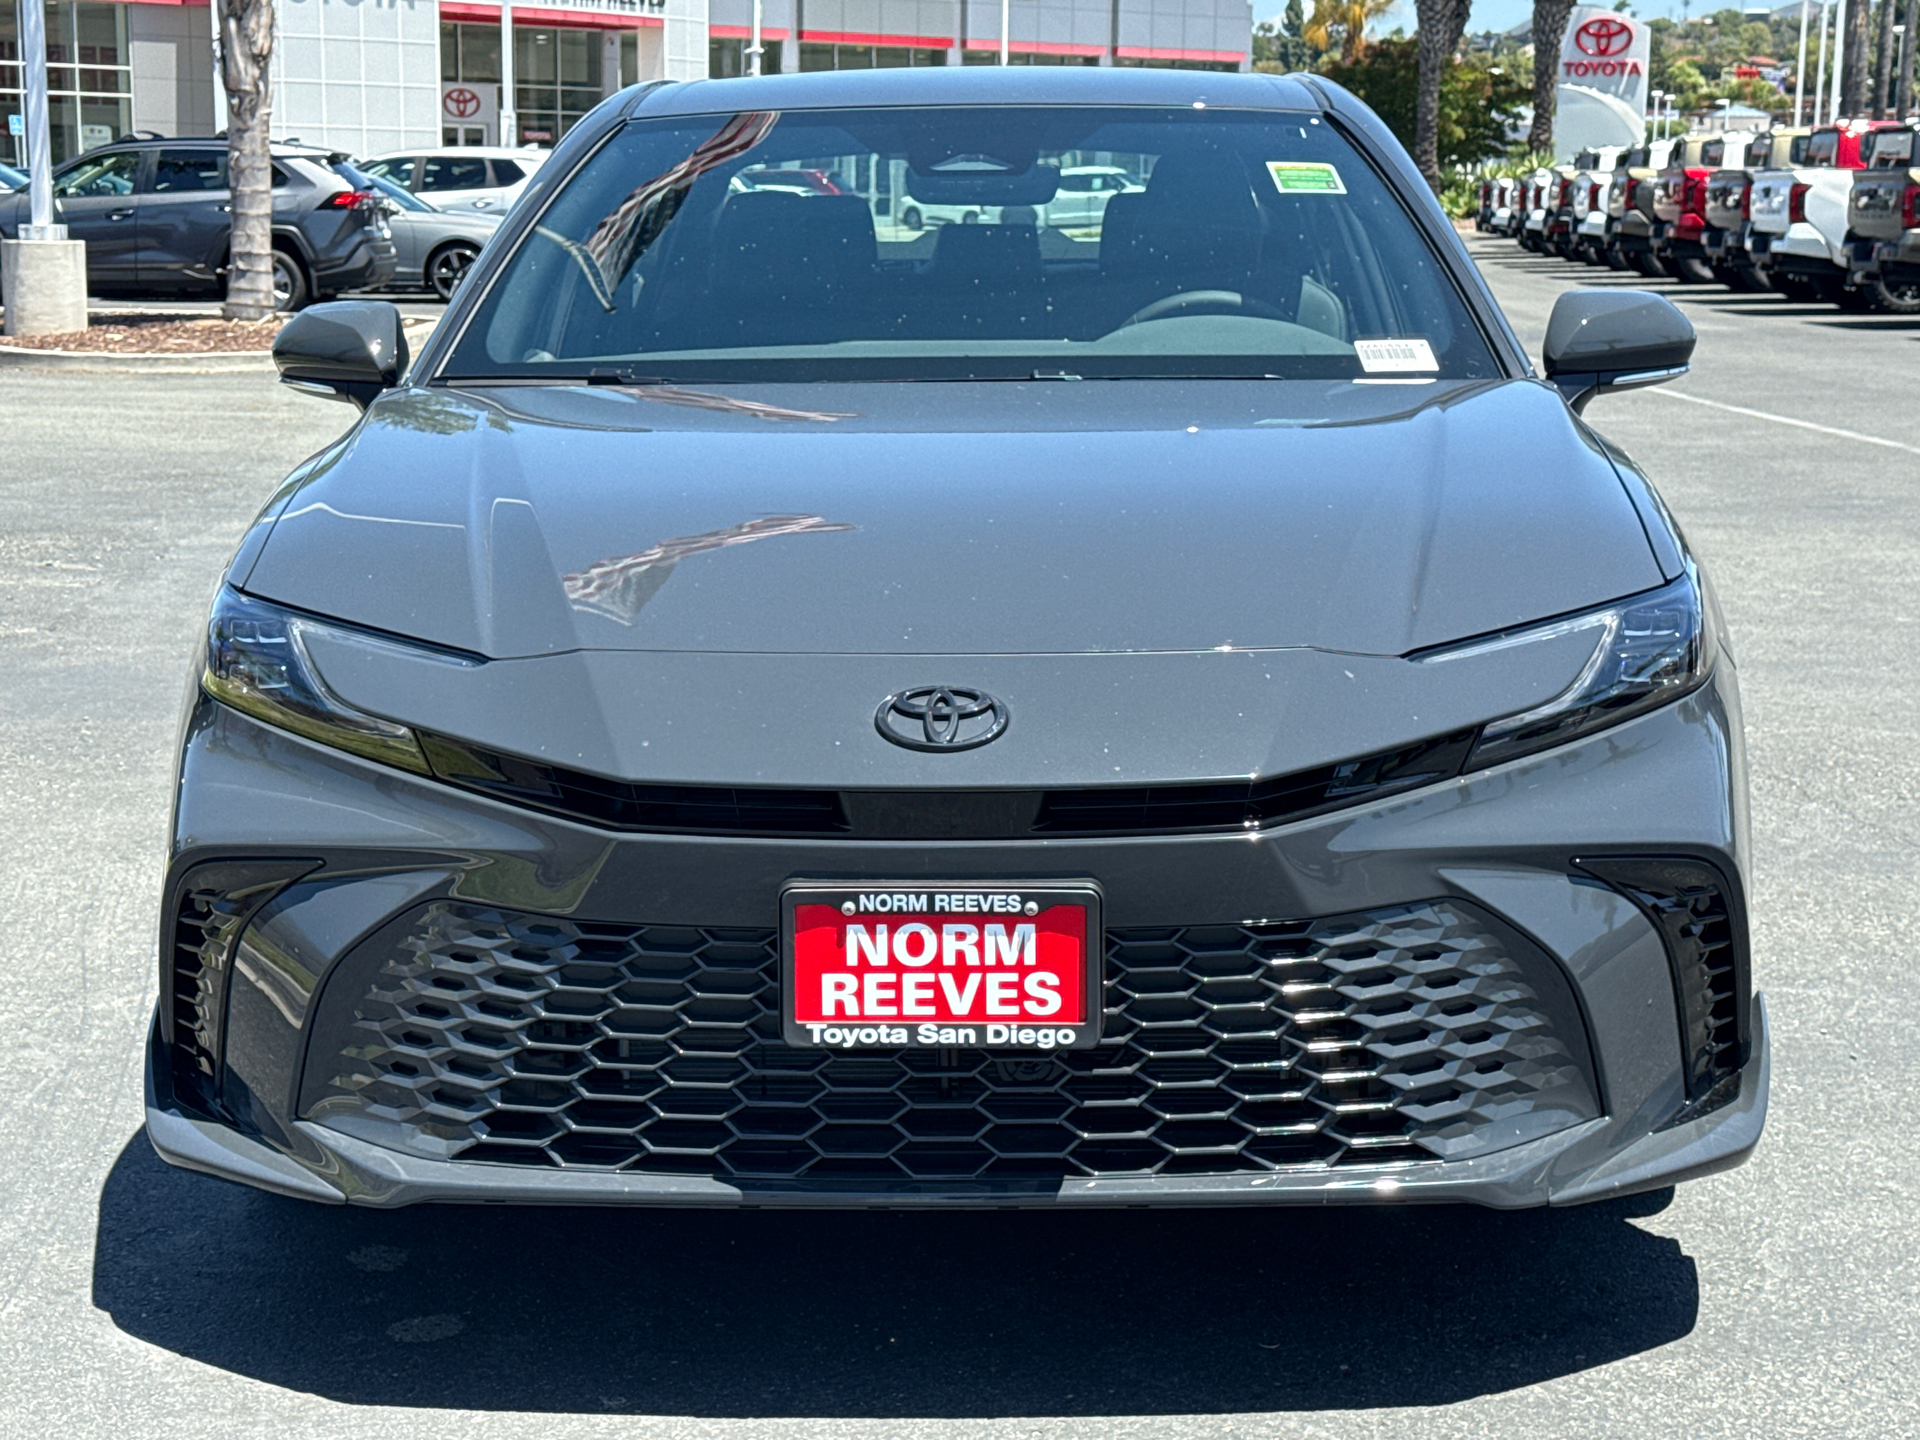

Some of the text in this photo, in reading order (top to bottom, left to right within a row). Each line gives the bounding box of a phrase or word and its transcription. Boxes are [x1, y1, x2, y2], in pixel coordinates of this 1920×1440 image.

[1562, 59, 1642, 77] TOYOTA
[859, 894, 1022, 912] NORM REEVES
[845, 923, 1037, 967] NORM
[821, 971, 1062, 1016] REEVES
[806, 1023, 1076, 1049] Toyota San Diego
